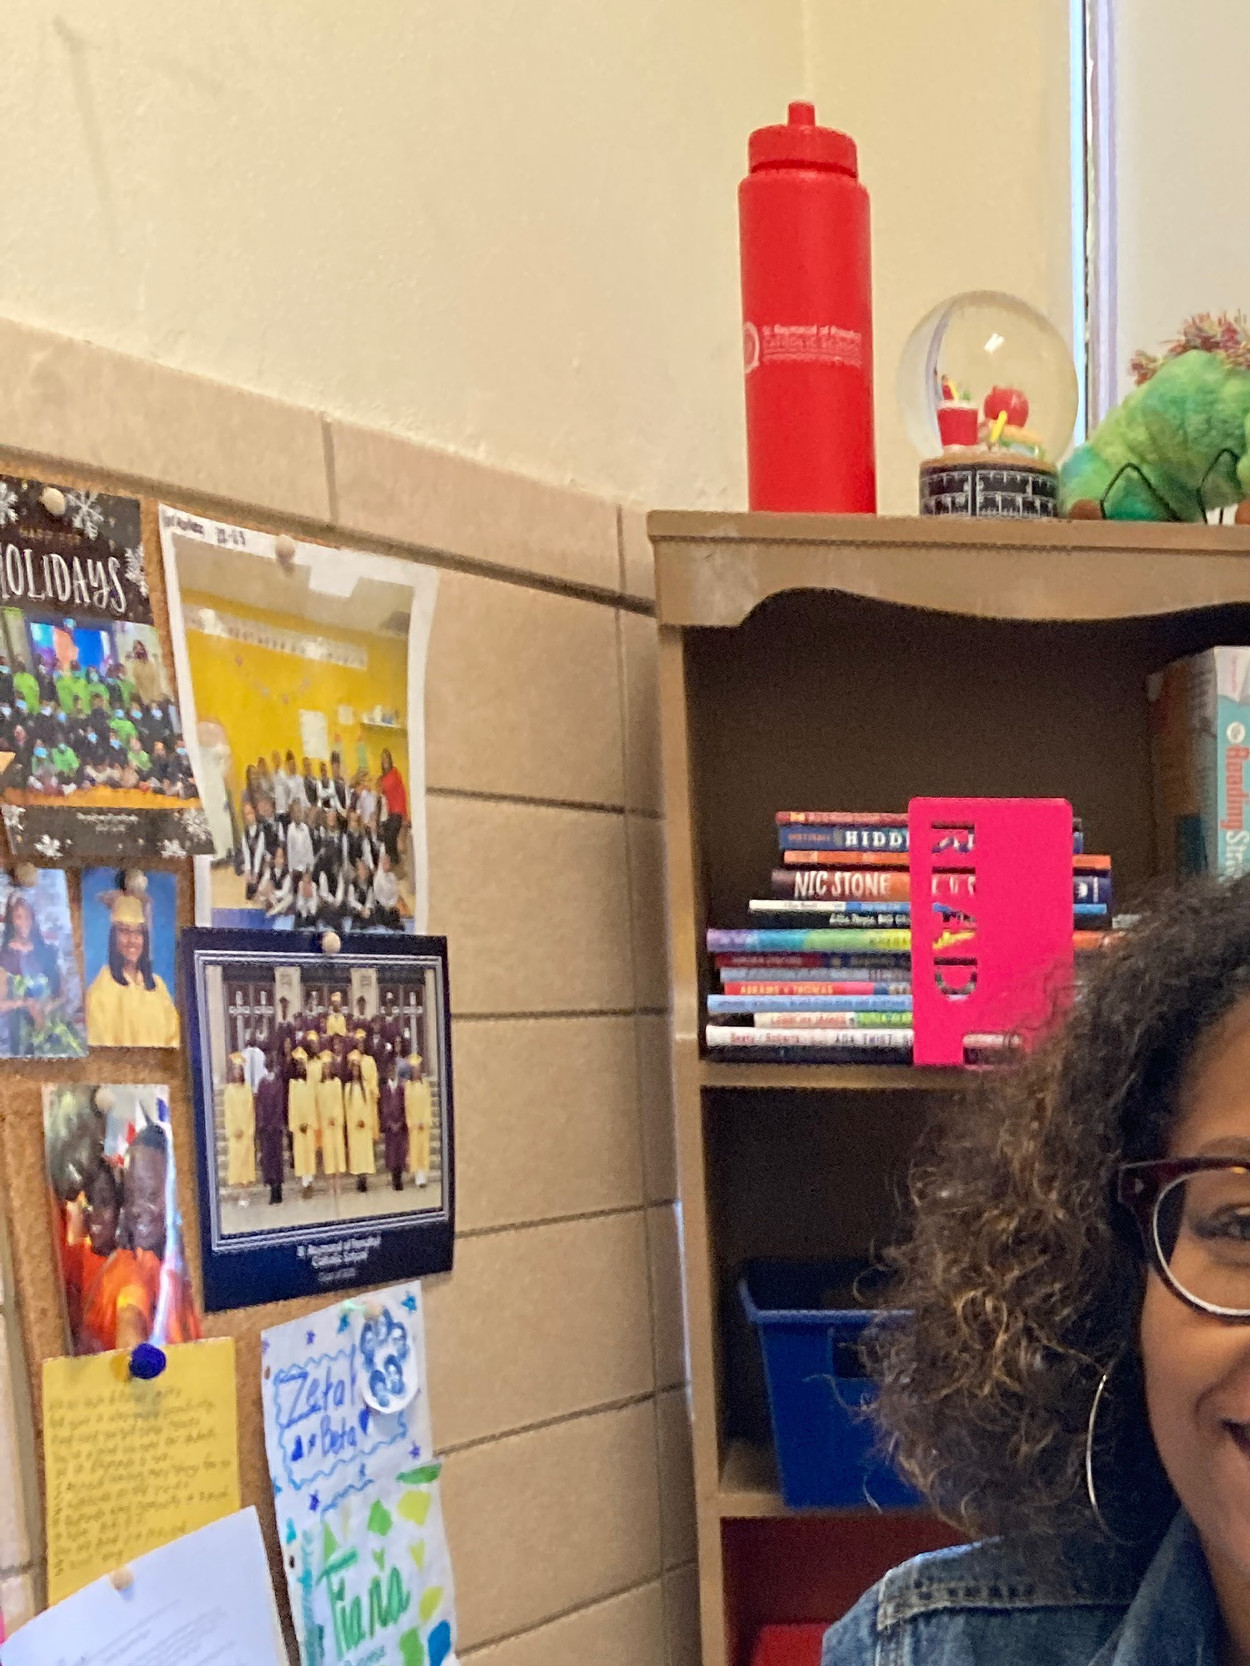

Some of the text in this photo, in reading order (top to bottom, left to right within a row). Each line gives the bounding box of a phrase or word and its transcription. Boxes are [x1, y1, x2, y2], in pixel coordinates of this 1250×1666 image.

[1220, 745, 1250, 830] Reading
[844, 830, 910, 848] HIDD
[793, 870, 893, 898] NIC STONE
[931, 822, 978, 1002] READ
